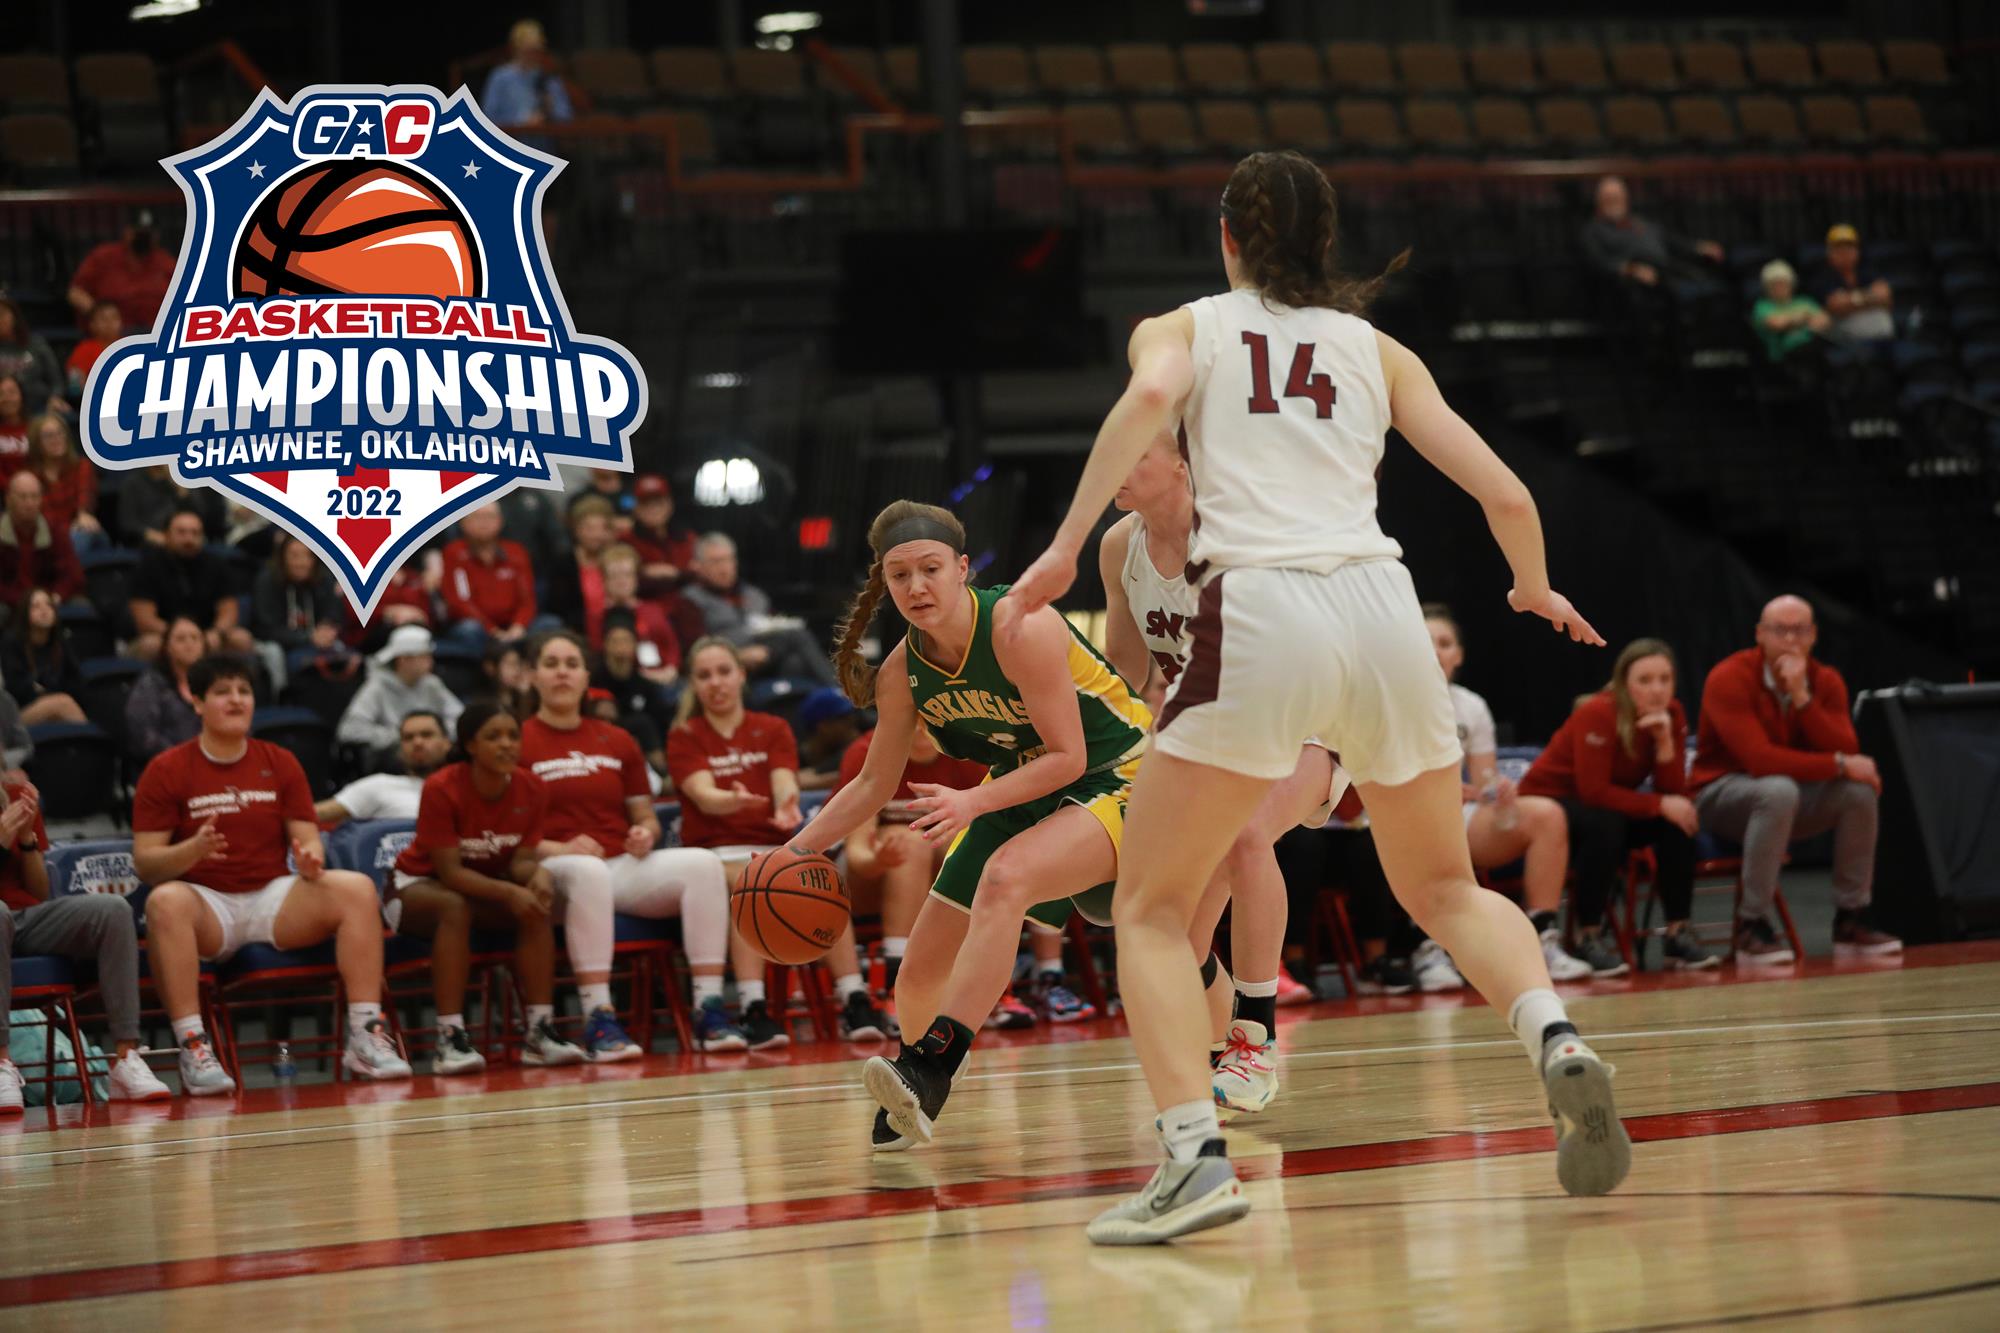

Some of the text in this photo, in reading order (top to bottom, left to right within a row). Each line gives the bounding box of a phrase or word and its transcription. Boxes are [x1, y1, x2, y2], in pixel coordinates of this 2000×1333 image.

[1240, 330, 1337, 420] 14
[918, 689, 1032, 728] ARKANSAS
[86, 856, 130, 871] GREAT
[68, 866, 138, 892] AMERICA
[797, 867, 832, 892] THE
